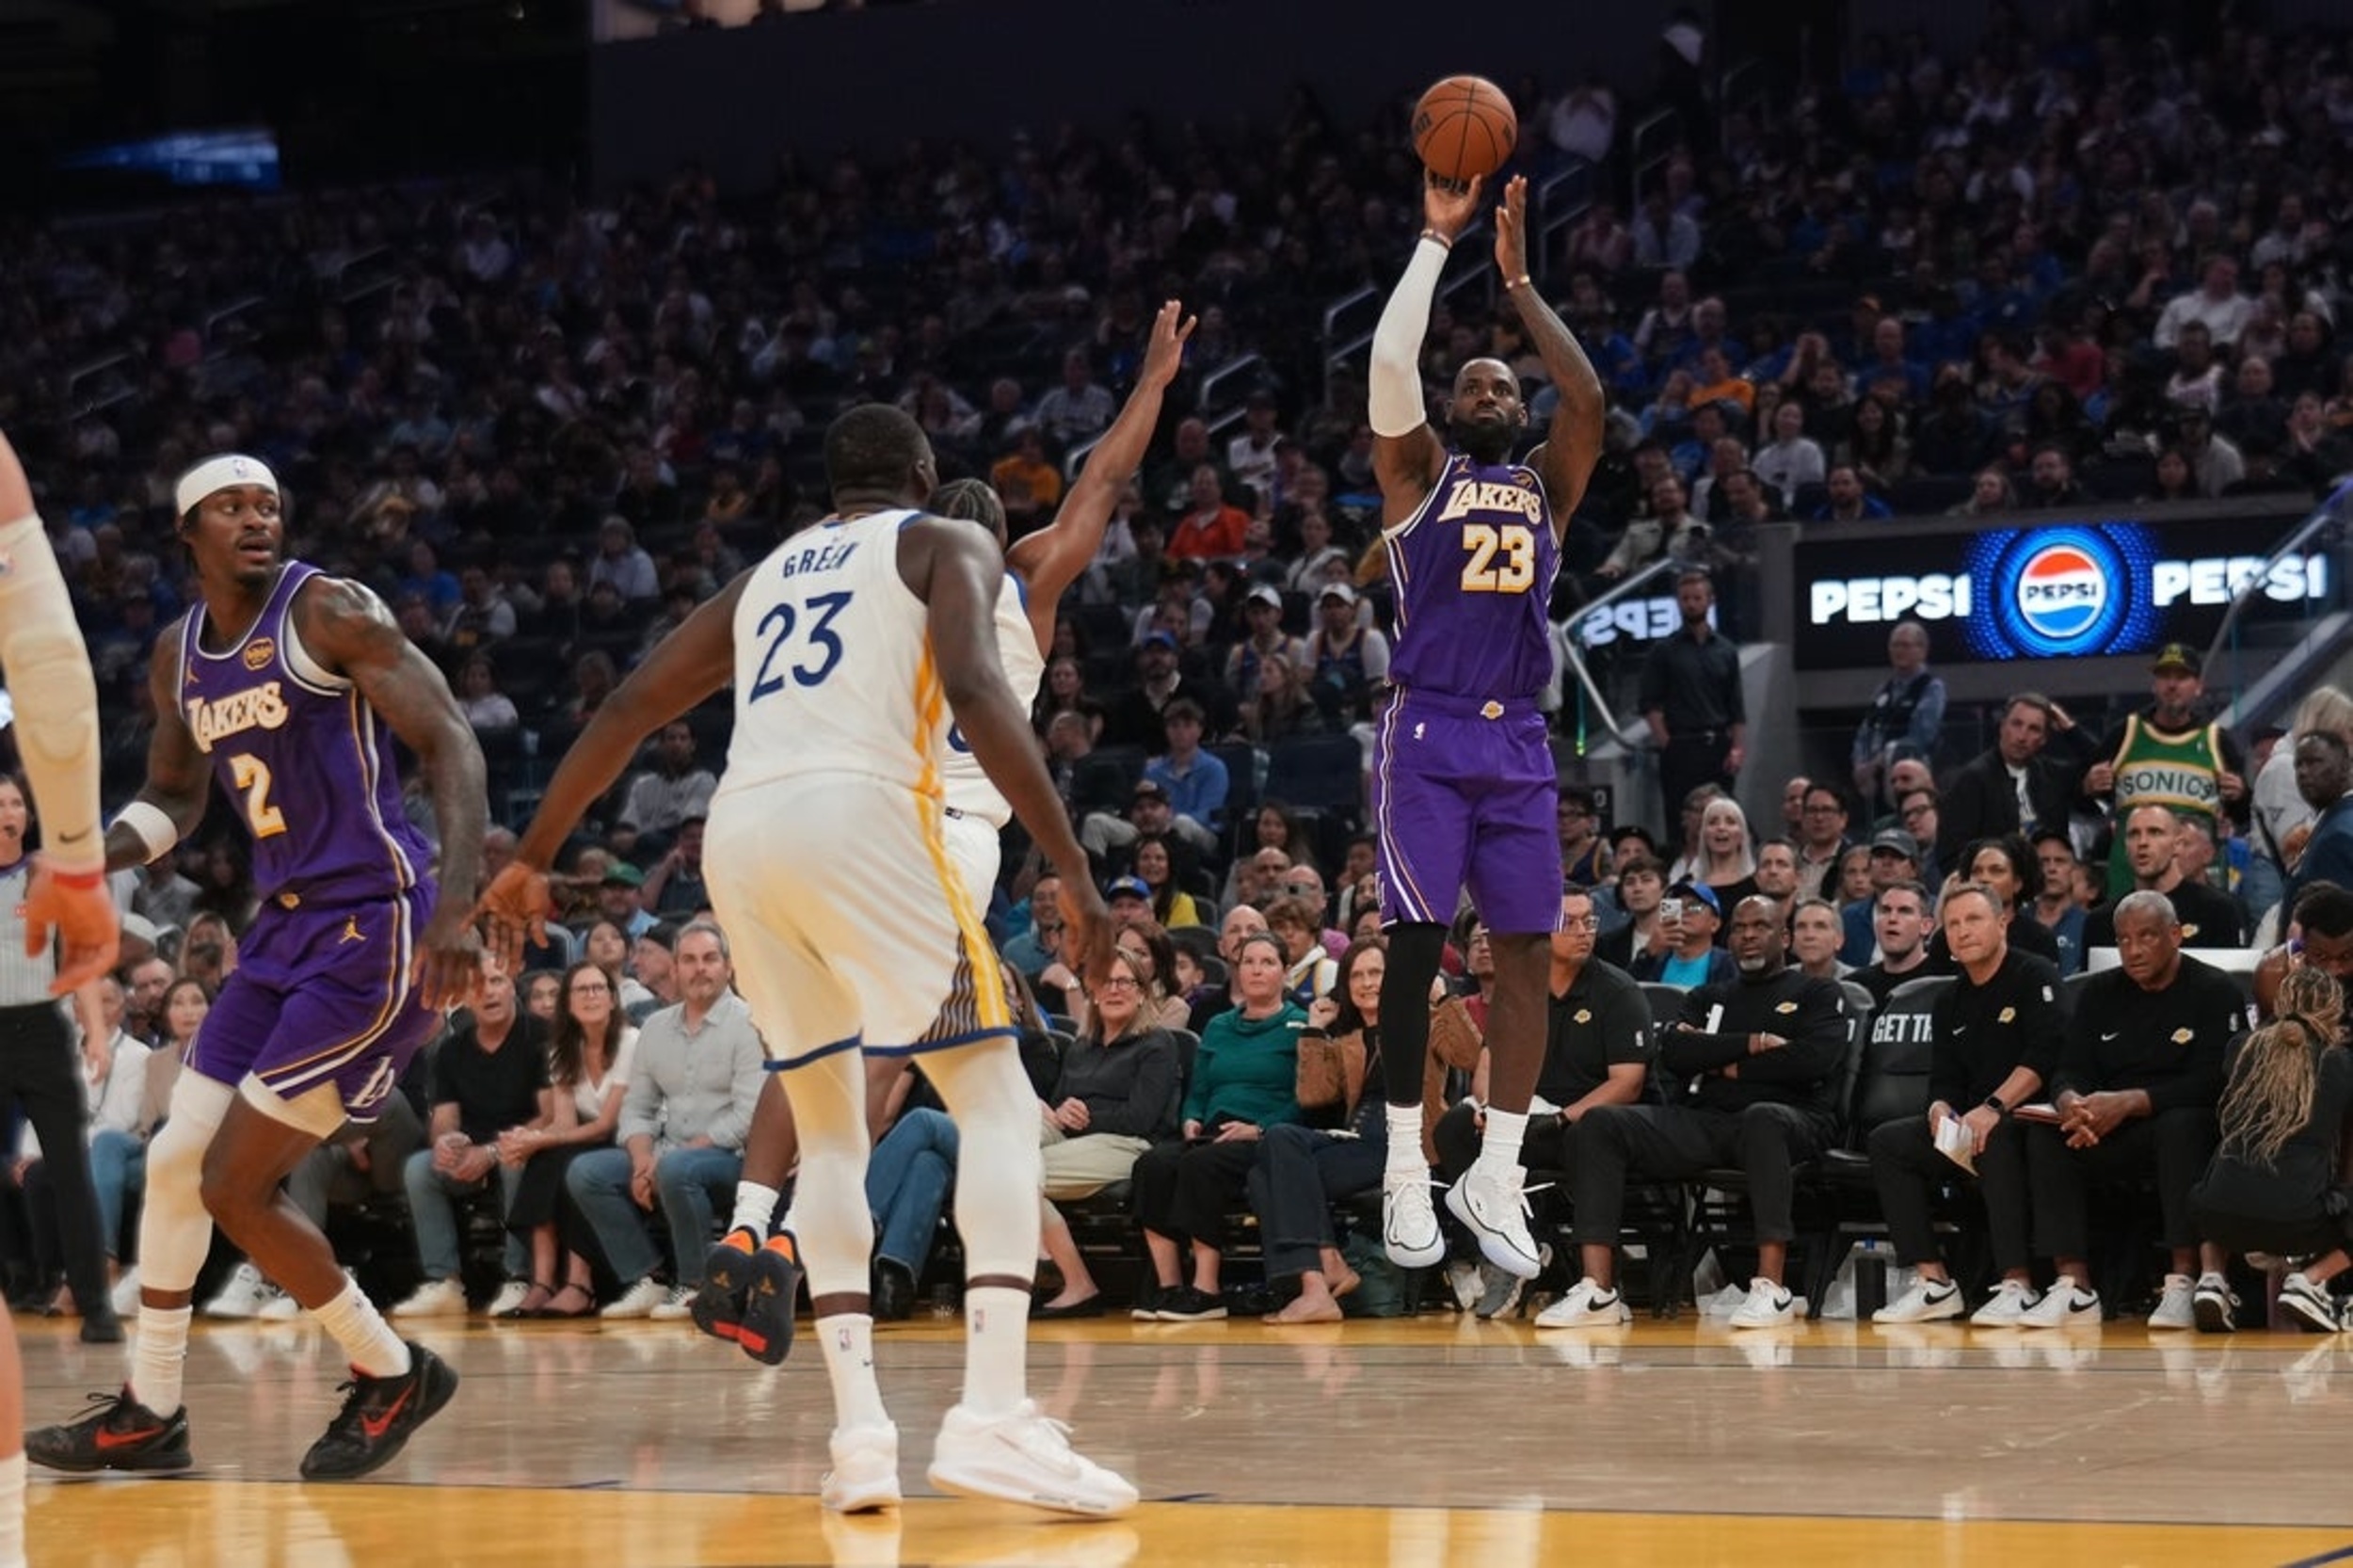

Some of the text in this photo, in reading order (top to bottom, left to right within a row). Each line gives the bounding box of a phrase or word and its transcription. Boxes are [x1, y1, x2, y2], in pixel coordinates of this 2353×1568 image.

[1436, 478, 1542, 524] LAKERS
[1461, 523, 1535, 594] 23
[2152, 552, 2327, 607] PEPSI
[1811, 572, 1972, 624] PEPSI
[2025, 583, 2097, 600] PEPSI
[749, 590, 854, 704] 23
[187, 681, 288, 753] LAKERS
[229, 753, 287, 838] 2
[2123, 771, 2213, 801] SONICS
[1871, 1013, 1911, 1045] GET
